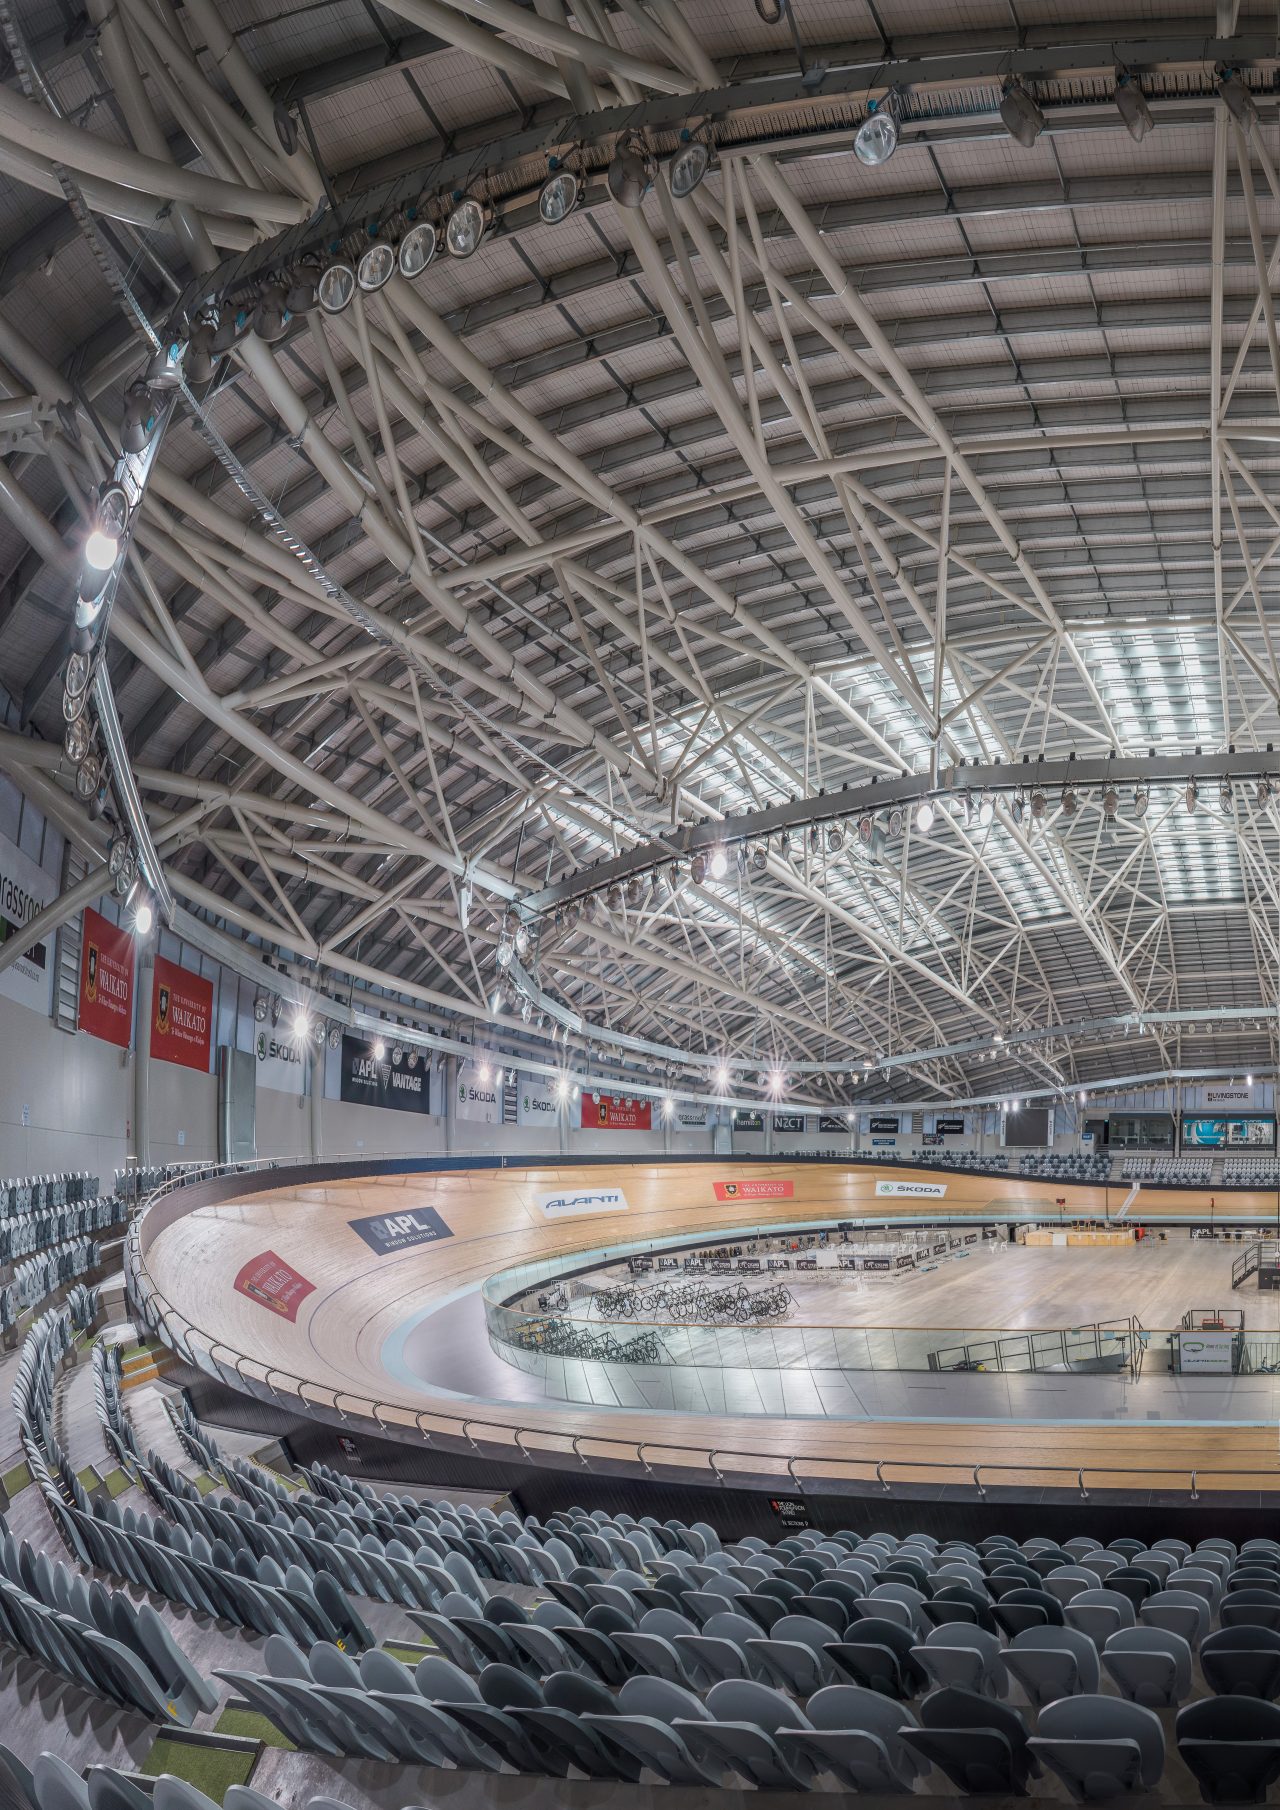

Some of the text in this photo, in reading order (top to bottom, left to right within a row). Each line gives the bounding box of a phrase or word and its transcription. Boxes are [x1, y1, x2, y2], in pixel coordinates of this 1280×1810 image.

[100, 968, 128, 1000] WAIKATO
[172, 1006, 206, 1033] WAIKATO
[358, 1058, 377, 1079] APL
[392, 1071, 422, 1092] VANTAGE
[469, 1089, 496, 1104] ŠKODA
[533, 1100, 556, 1112] ŠKODA
[610, 1111, 637, 1122] WAIKATO
[774, 1118, 803, 1129] NZCT
[897, 1183, 941, 1194] ŠKODA
[384, 1214, 429, 1237] APL
[663, 1258, 676, 1266] APL
[690, 1258, 703, 1266] APL
[262, 1269, 293, 1295] WAIKATO
